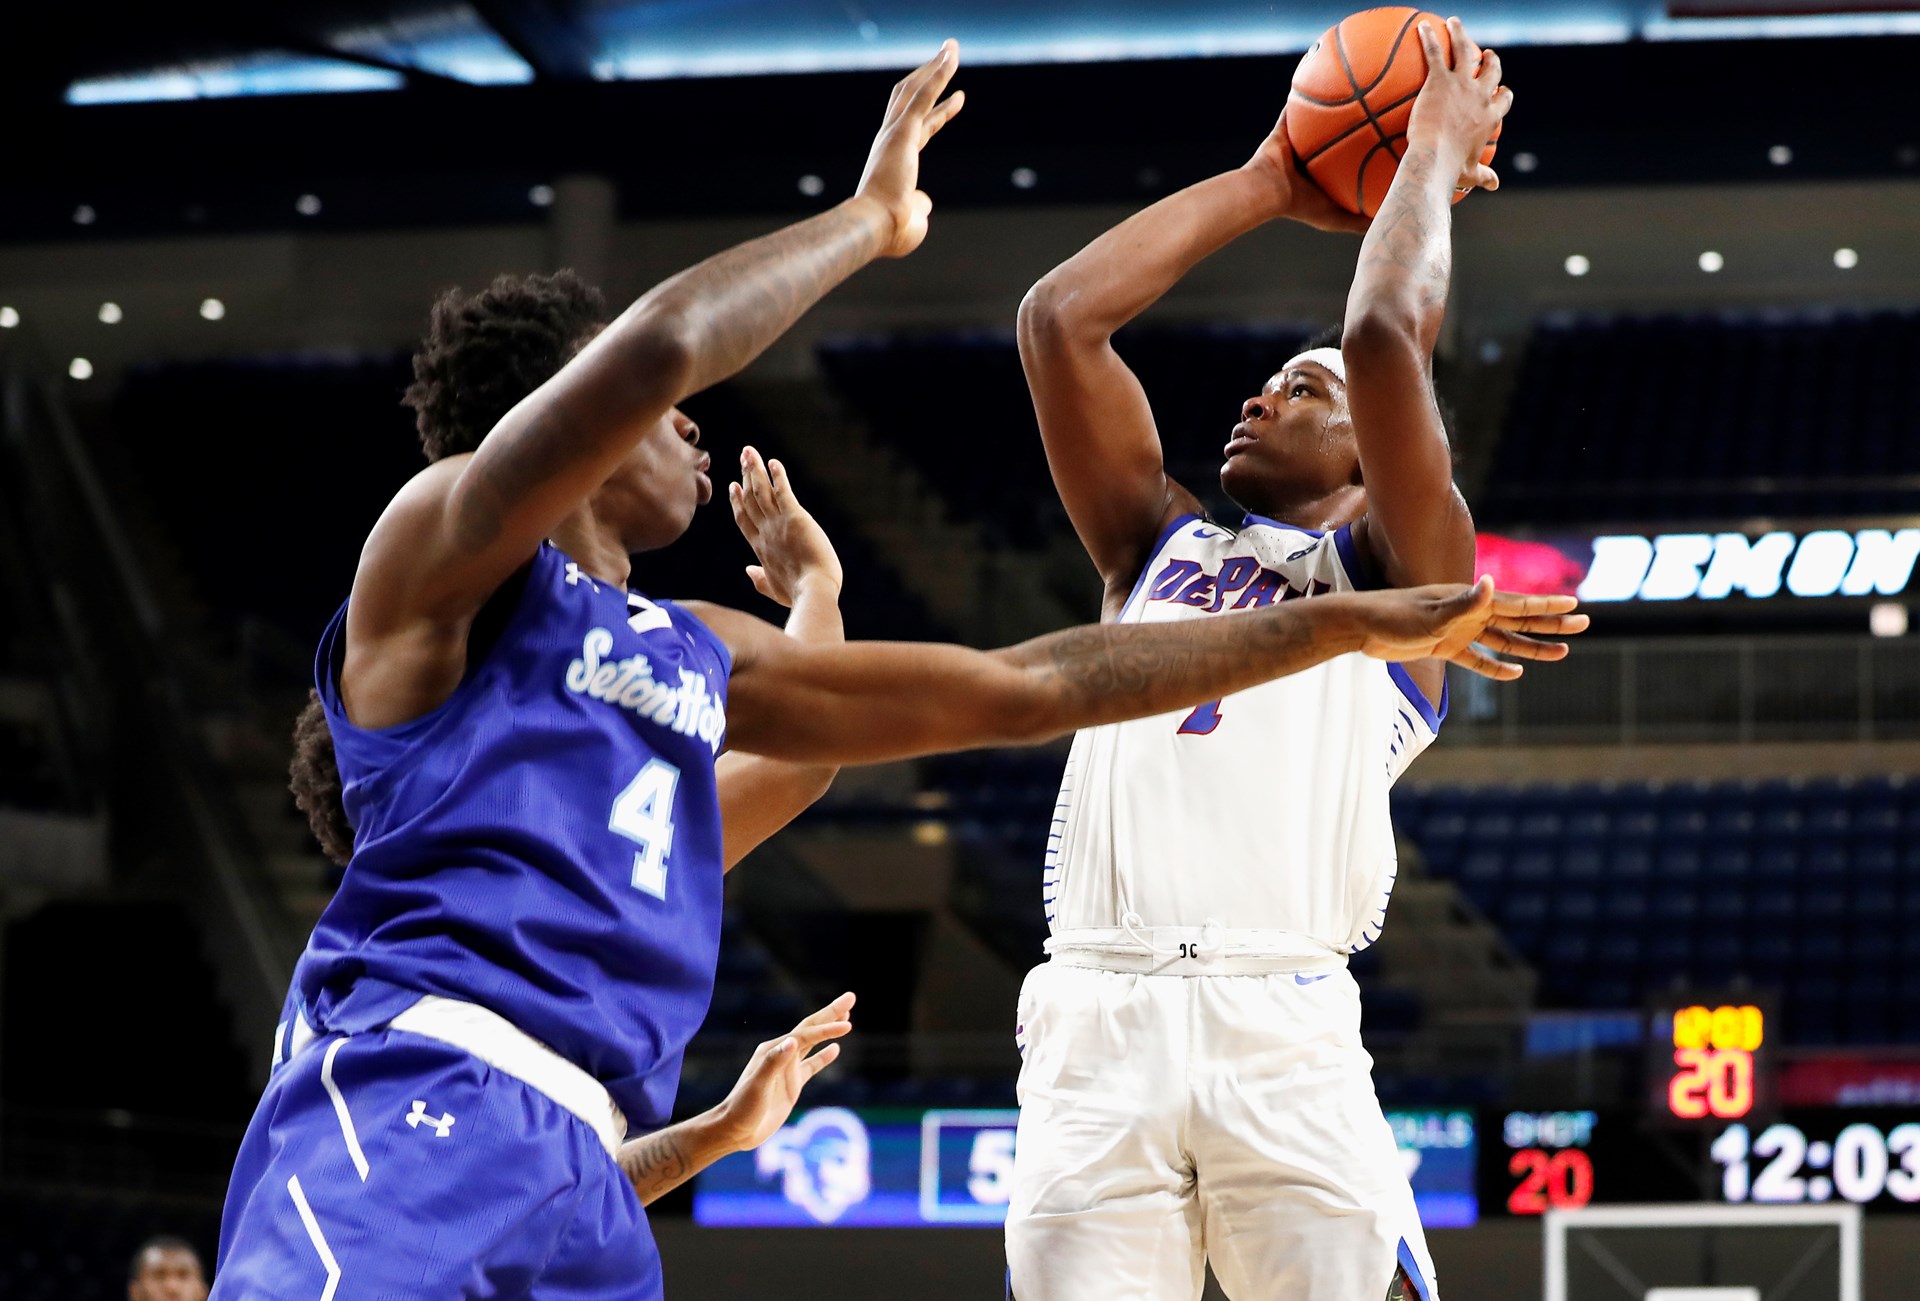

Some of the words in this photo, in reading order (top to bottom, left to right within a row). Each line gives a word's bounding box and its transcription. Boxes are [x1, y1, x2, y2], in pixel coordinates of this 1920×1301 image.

[1149, 556, 1331, 613] DEPA
[565, 626, 678, 726] Seton
[608, 757, 681, 902] 4
[1669, 1049, 1755, 1119] 20
[1507, 1148, 1594, 1215] 20
[1711, 1122, 1920, 1202] 12:03
